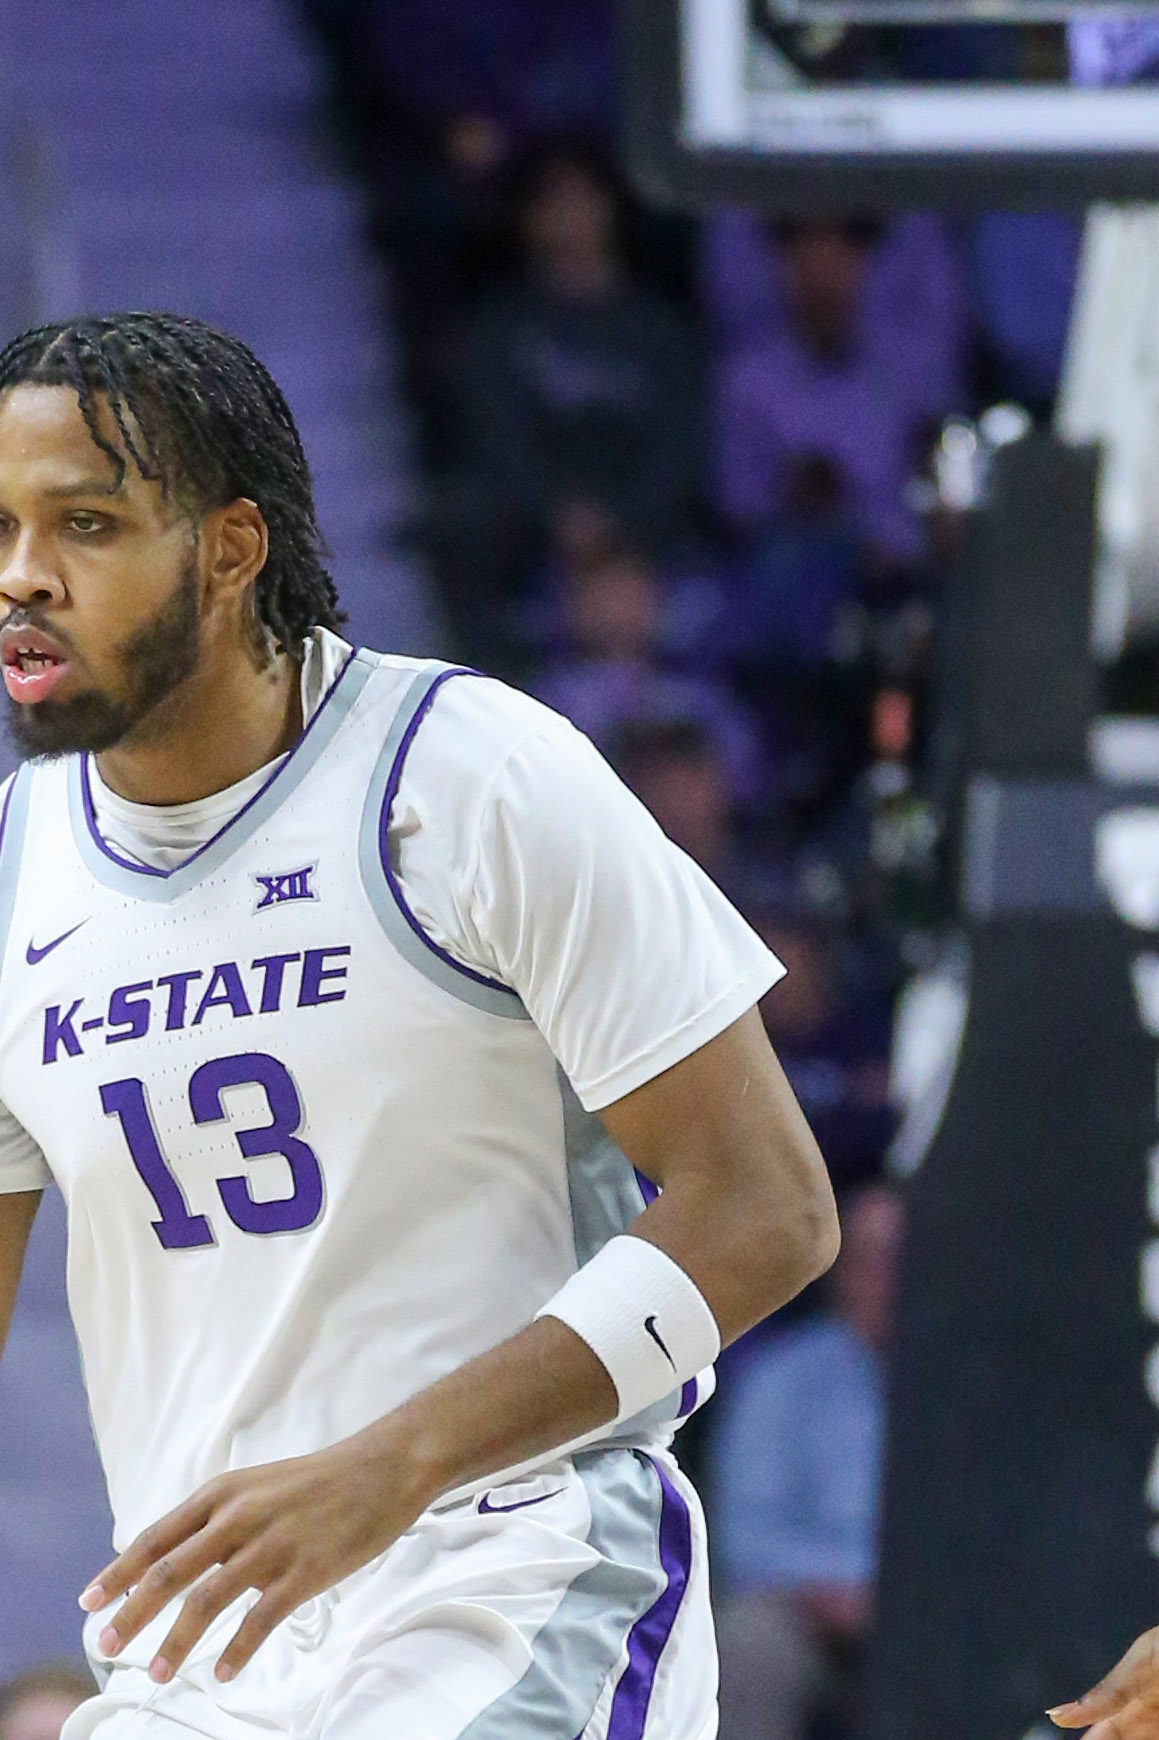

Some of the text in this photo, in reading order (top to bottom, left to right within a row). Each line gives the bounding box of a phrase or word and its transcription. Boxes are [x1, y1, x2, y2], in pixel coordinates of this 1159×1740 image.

[255, 865, 315, 909] XII
[42, 945, 352, 1066] K-STATE
[98, 1052, 326, 1250] 13
